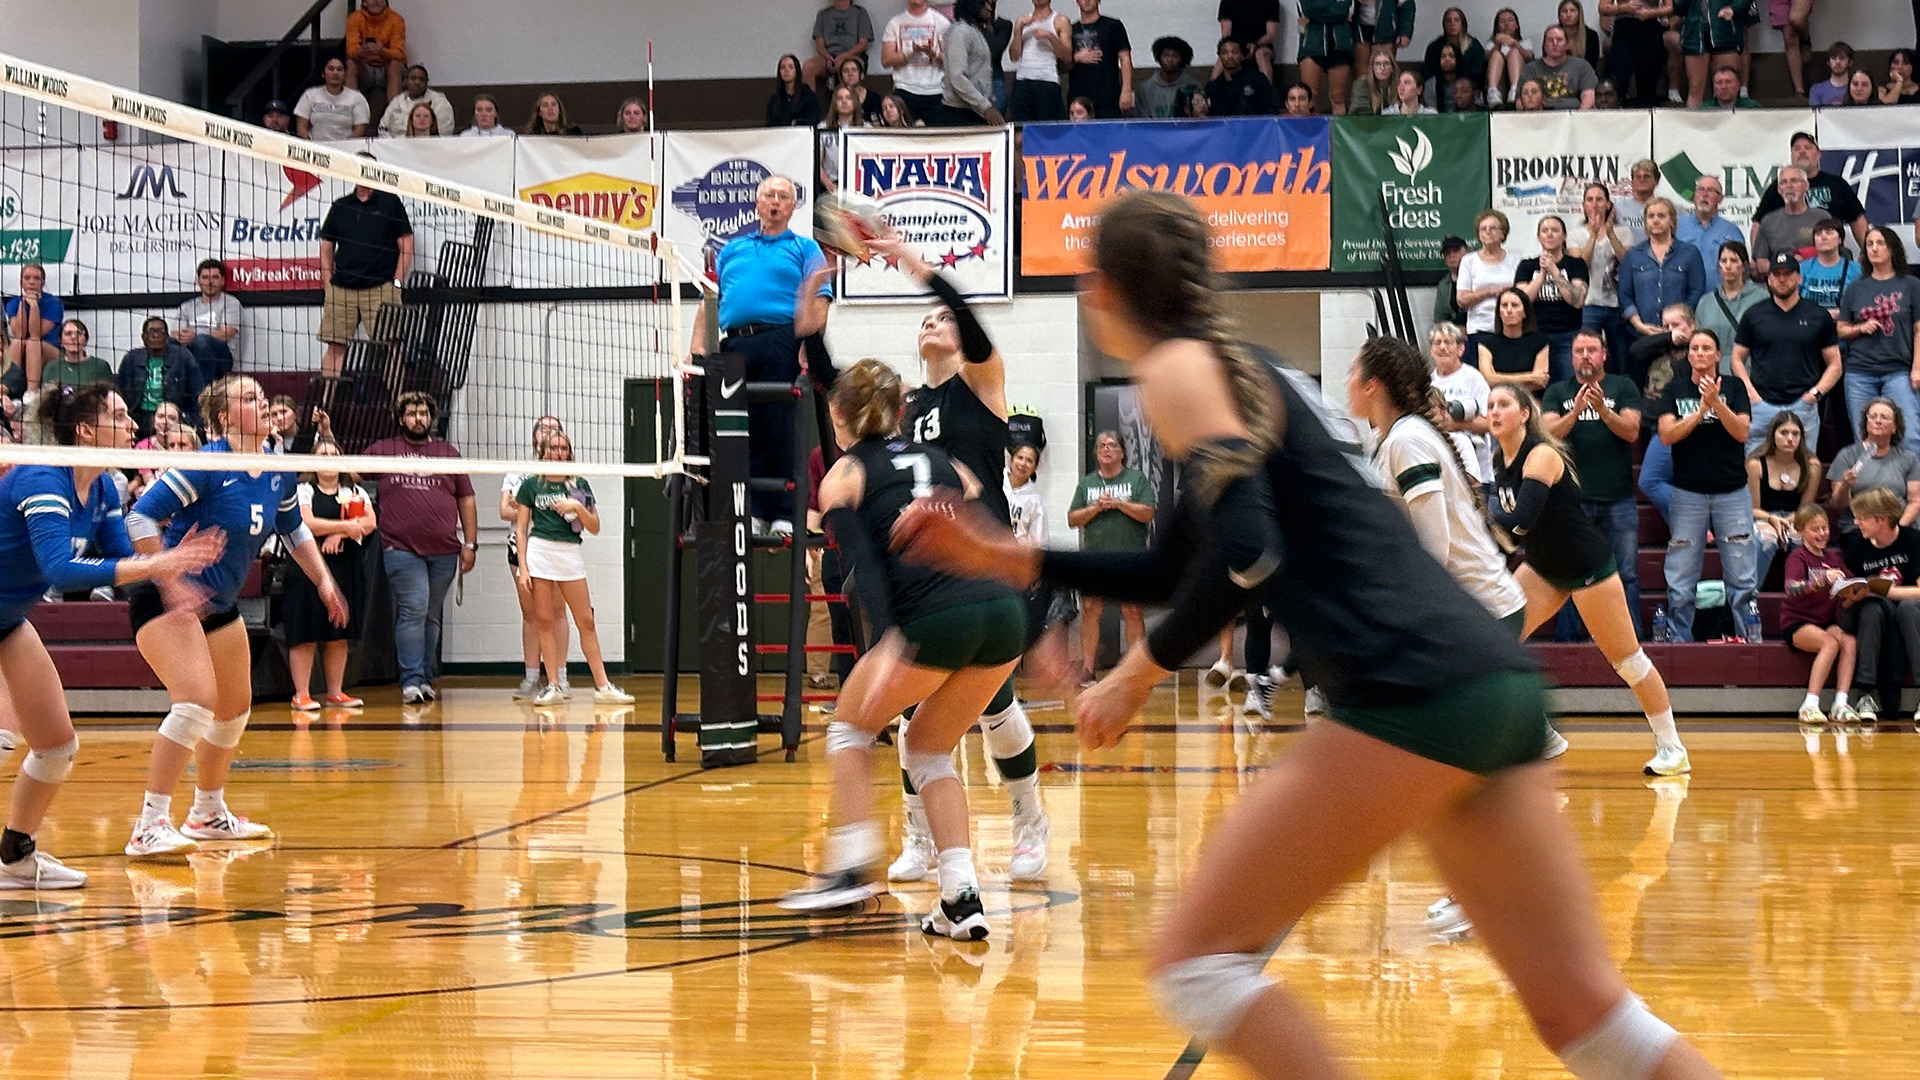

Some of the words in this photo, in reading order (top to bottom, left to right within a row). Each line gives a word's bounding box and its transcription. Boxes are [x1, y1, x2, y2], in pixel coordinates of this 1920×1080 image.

[5, 64, 40, 90] WILLIAM
[42, 75, 69, 98] WOODS
[112, 94, 142, 118] WILLIAM
[144, 105, 167, 125] WOODS
[204, 120, 231, 142] WILLIAM
[232, 130, 253, 149] WOODS
[711, 170, 763, 185] BRICK
[729, 161, 747, 169] THE
[860, 156, 986, 202] NAIA
[1022, 145, 1331, 200] Walsworth
[1496, 154, 1619, 188] BROOKLYN
[698, 188, 756, 204] DISTRI
[1382, 181, 1442, 210] Fresh
[82, 214, 116, 234] JOE
[123, 211, 220, 234] MACHENS
[880, 211, 968, 229] Champions
[1208, 208, 1289, 228] delivering
[10, 238, 40, 260] 1925
[109, 240, 192, 253] DEALERSHIPS
[897, 229, 975, 243] Character
[1065, 234, 1091, 251] the
[1205, 231, 1287, 248] periences
[913, 406, 941, 444] 13
[890, 453, 933, 498] 7
[249, 504, 264, 536] 5
[732, 482, 748, 676] WOODS
